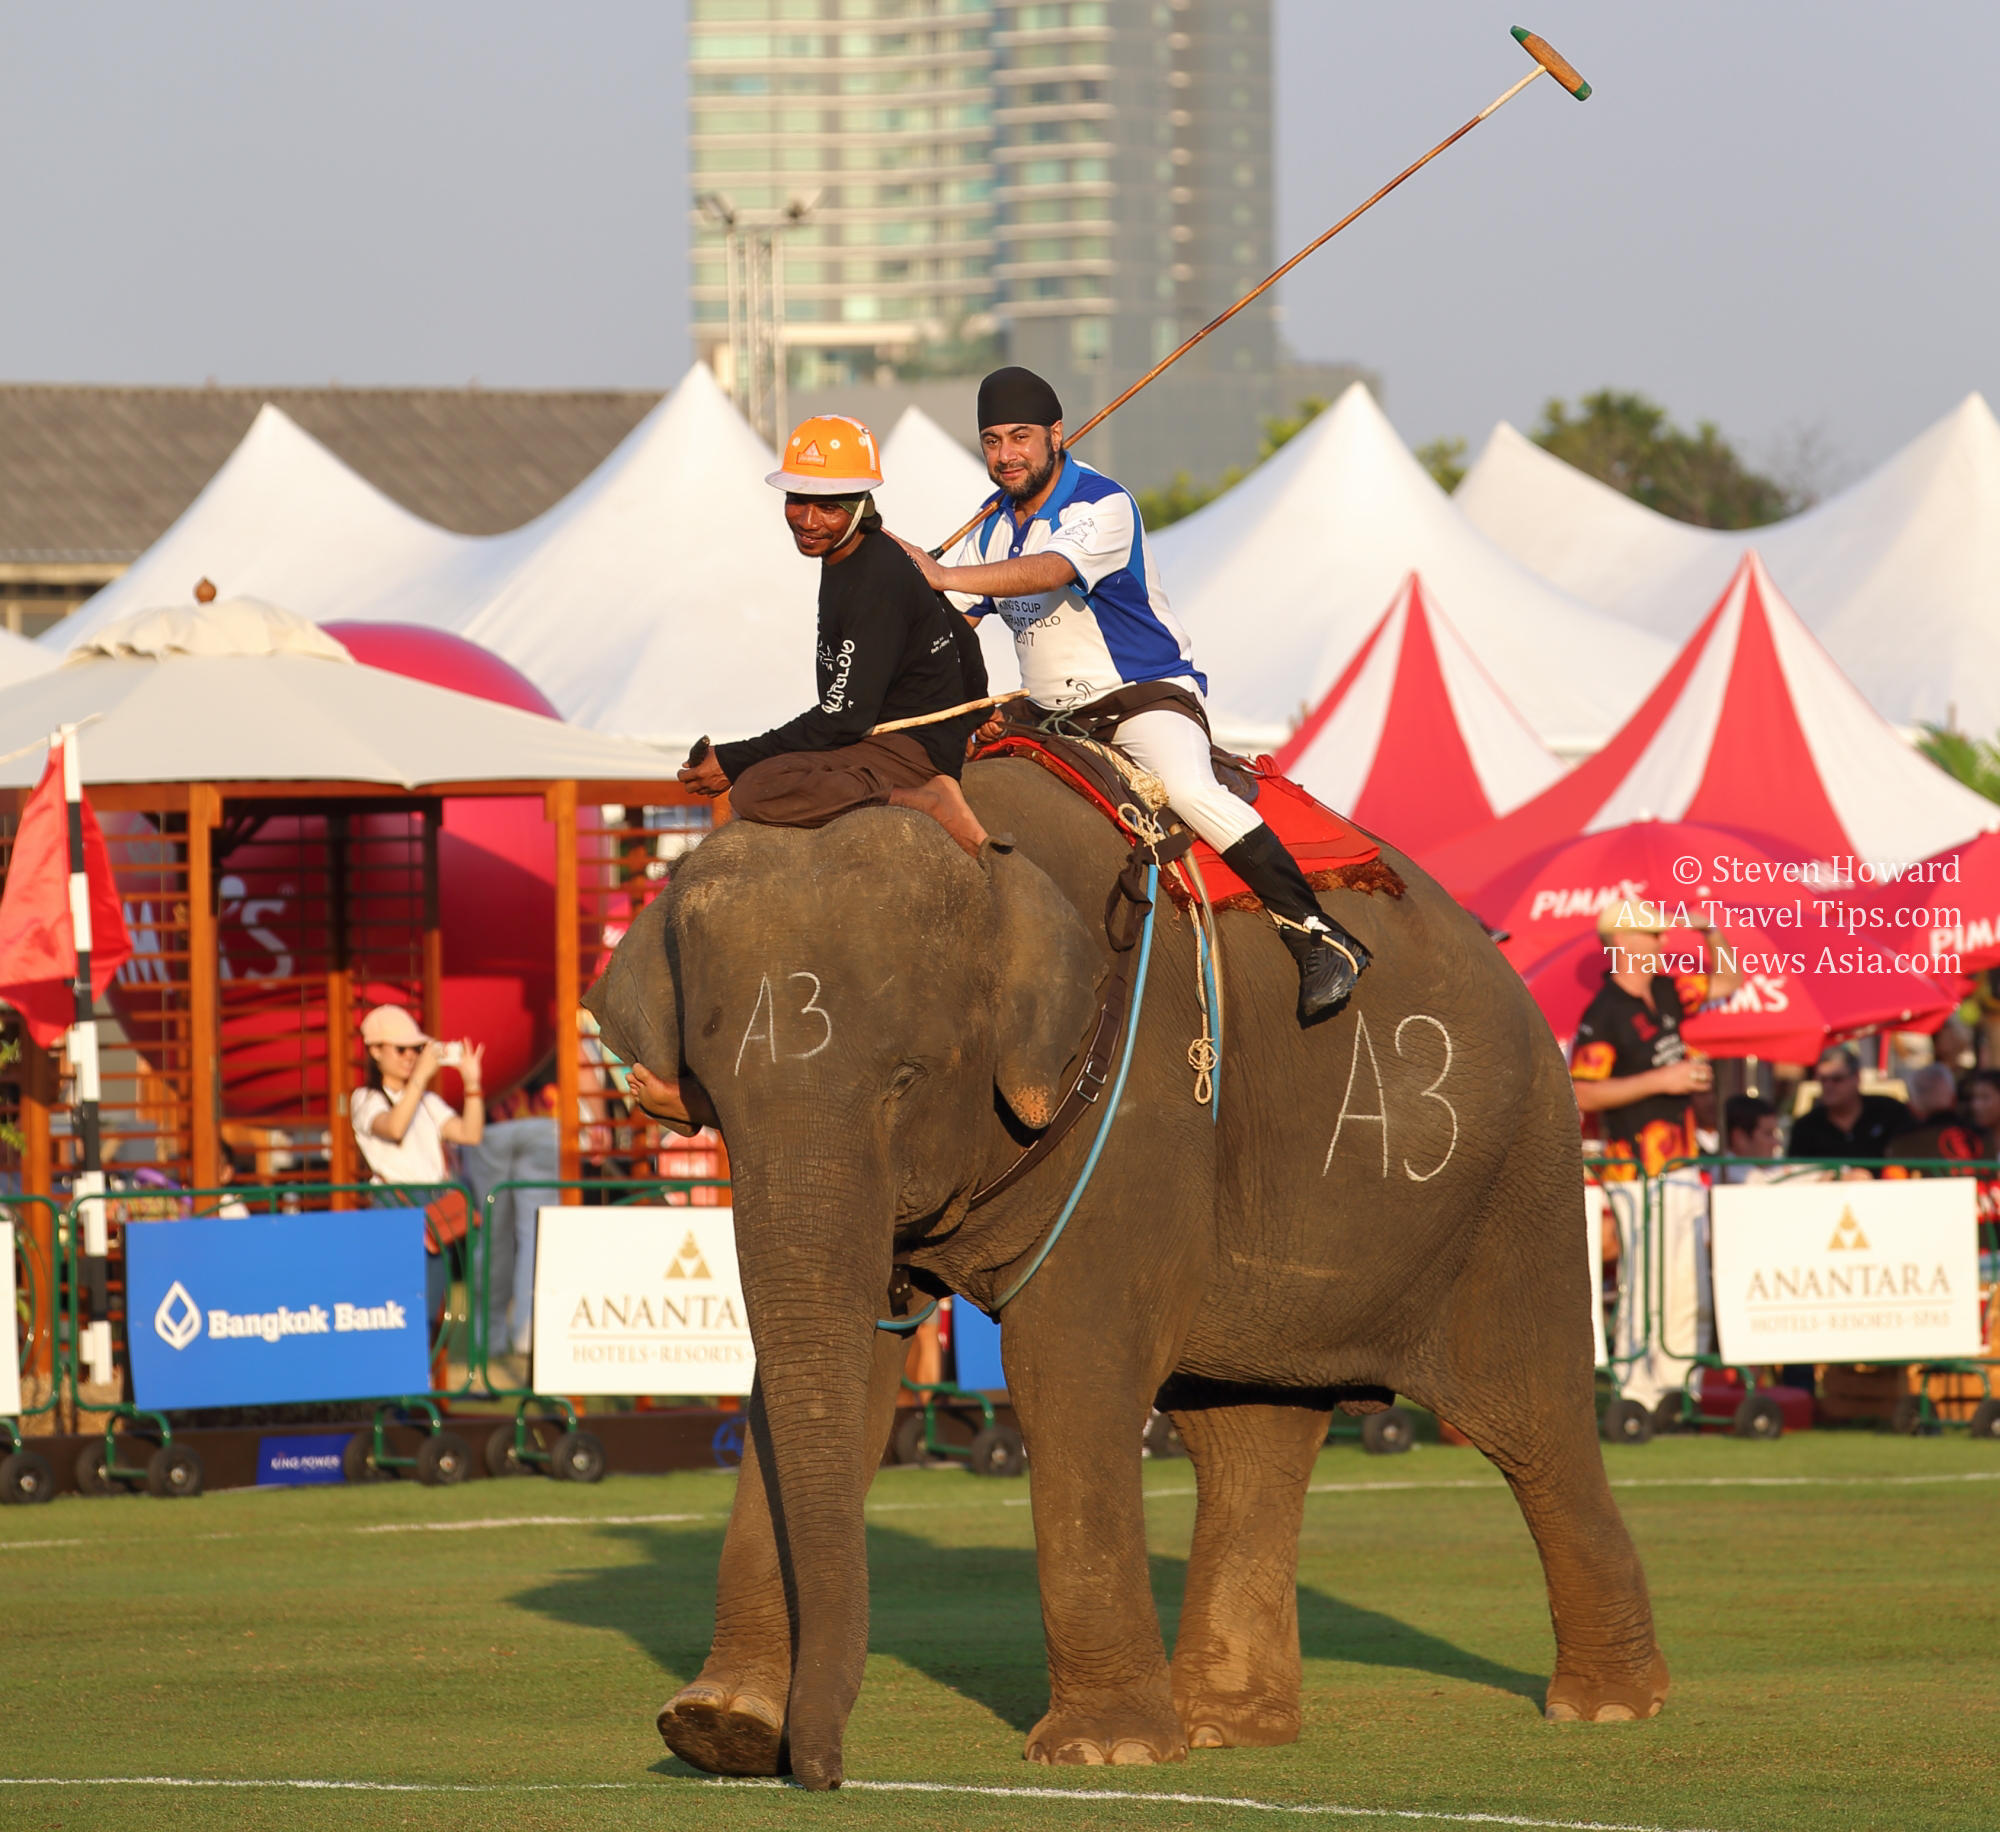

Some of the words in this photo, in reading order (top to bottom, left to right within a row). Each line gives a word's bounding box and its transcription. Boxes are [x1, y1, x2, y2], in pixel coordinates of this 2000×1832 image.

[1022, 602, 1041, 613] CUP
[1029, 616, 1061, 628] POLO
[1929, 914, 2000, 961] PIM
[734, 971, 832, 1076] A3
[1322, 1010, 1458, 1182] A3
[1746, 1262, 1952, 1300] ANANTARA
[208, 1306, 330, 1343] Bangkok
[334, 1300, 407, 1332] Bank
[569, 1294, 750, 1329] ANANTA
